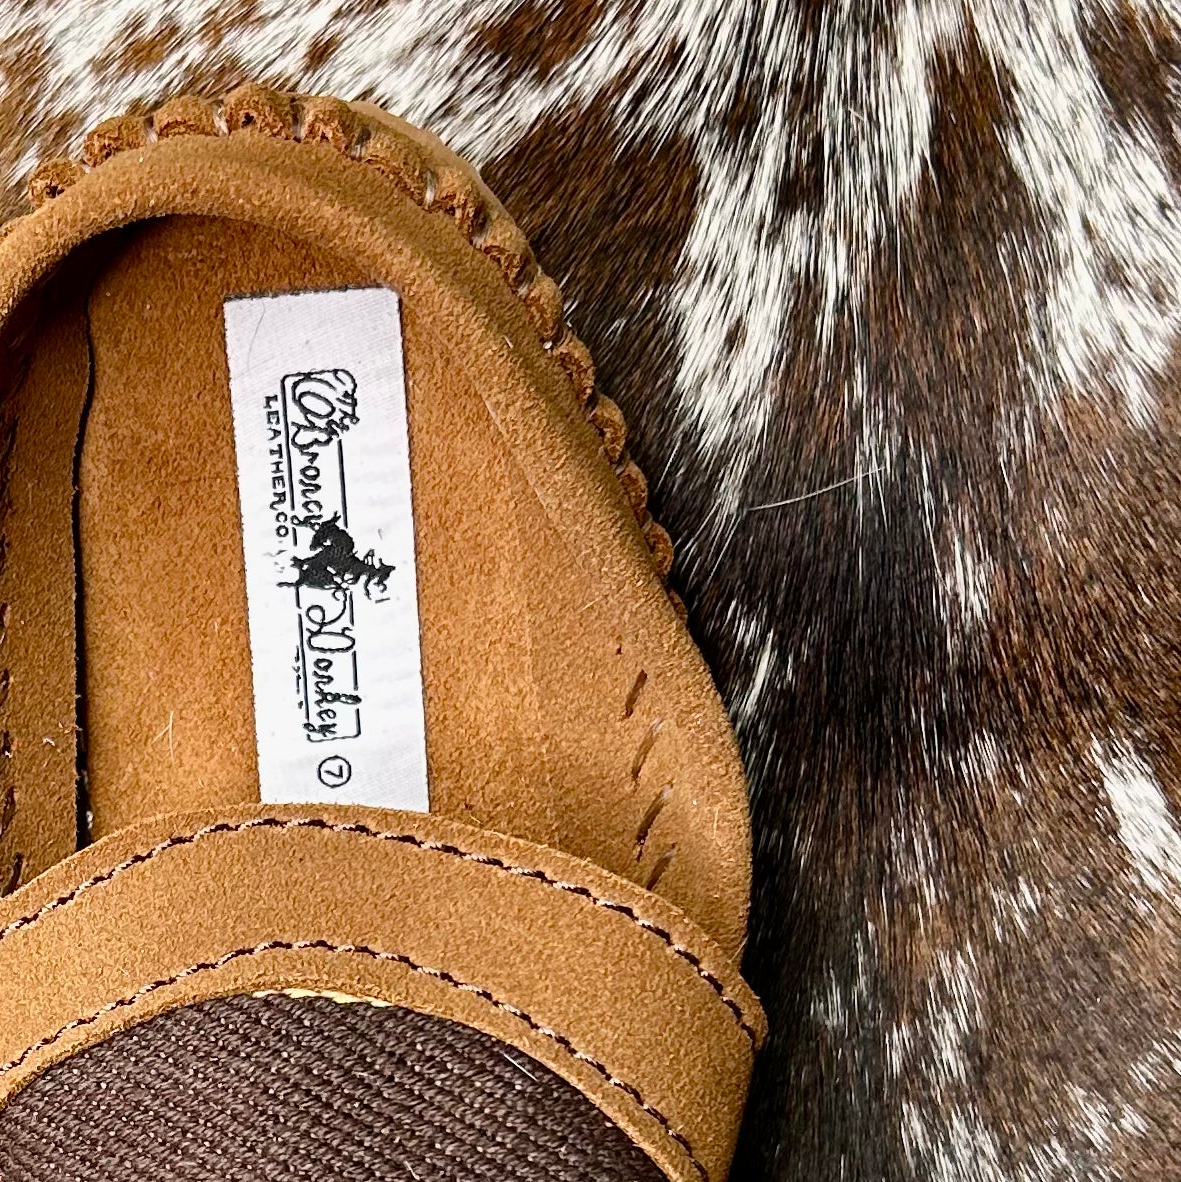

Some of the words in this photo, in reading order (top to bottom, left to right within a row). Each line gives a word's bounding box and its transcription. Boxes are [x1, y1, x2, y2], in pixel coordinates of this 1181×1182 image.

[263, 394, 287, 511] LEATHER
[325, 369, 360, 438] The
[303, 590, 362, 738] Donkey
